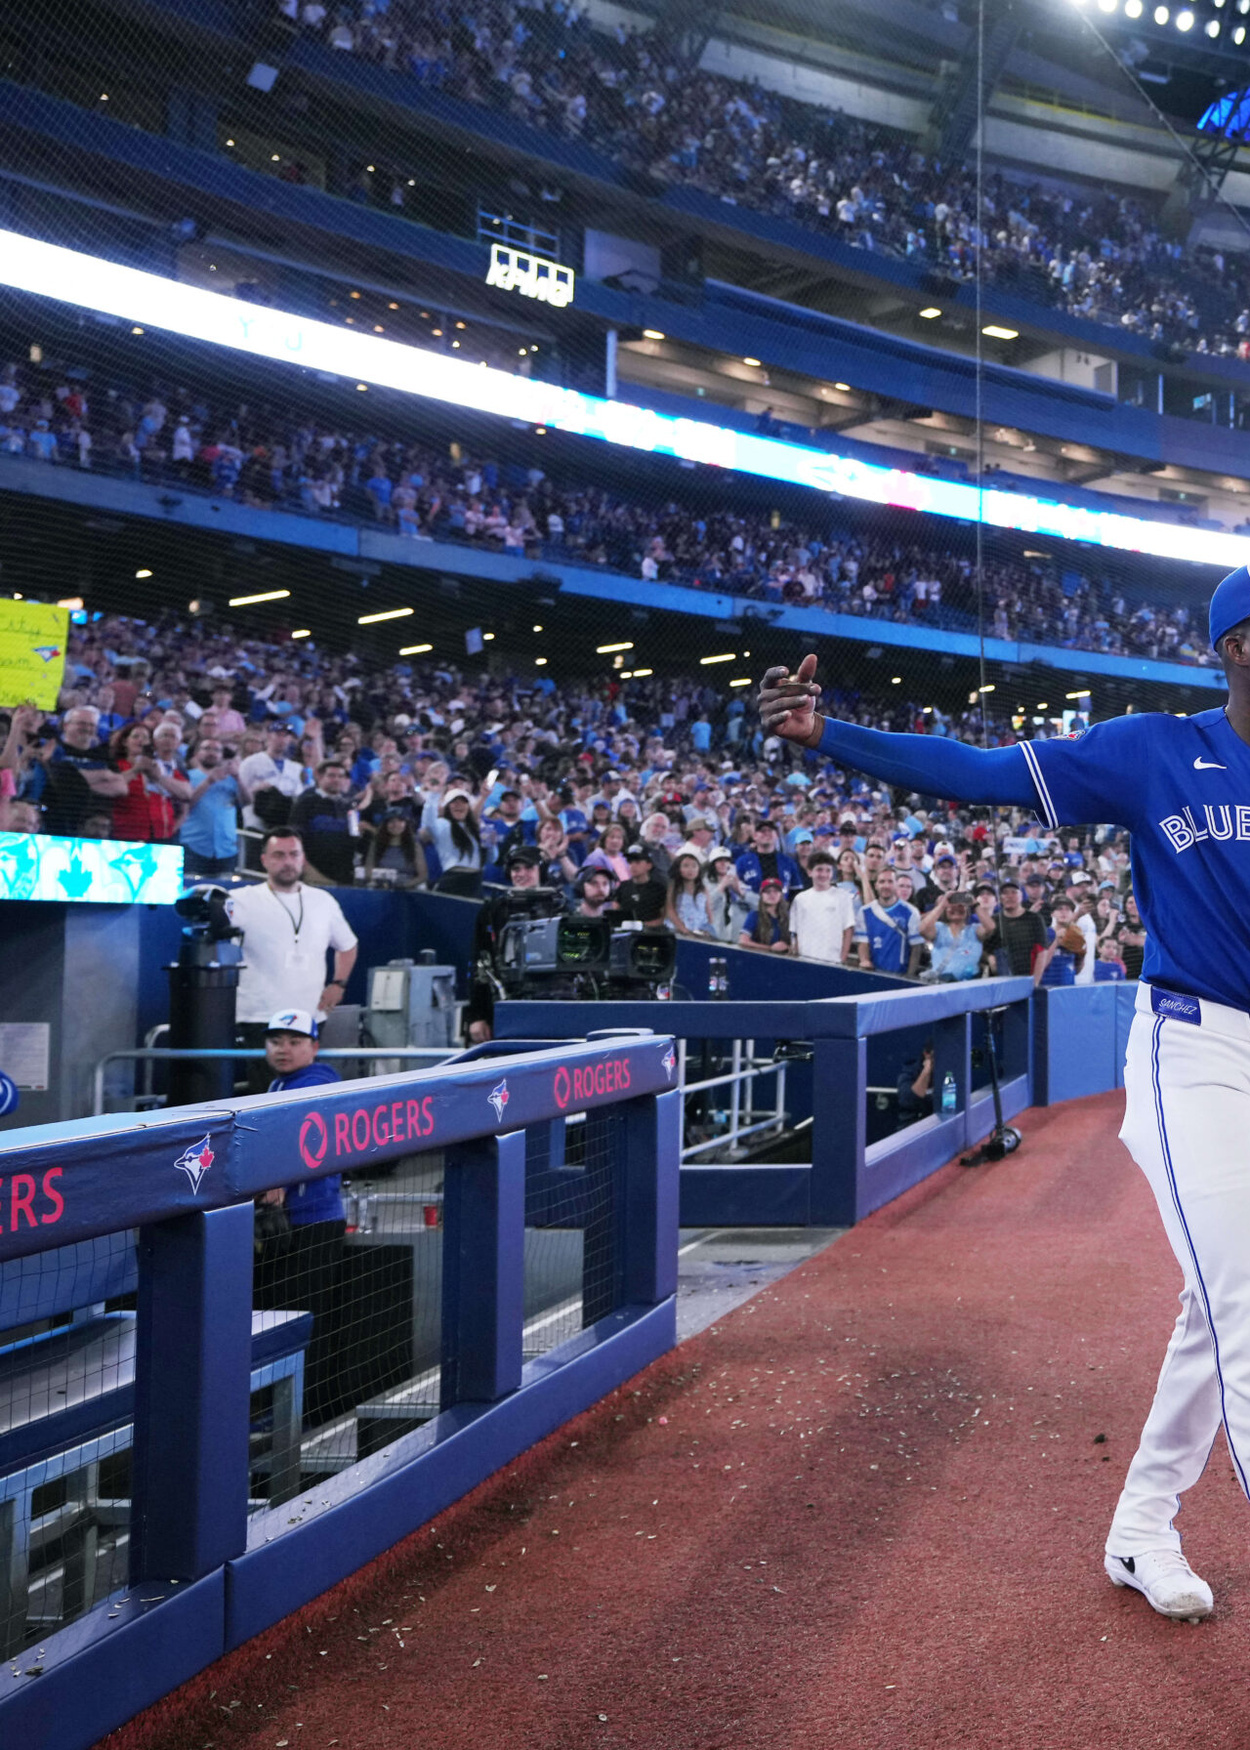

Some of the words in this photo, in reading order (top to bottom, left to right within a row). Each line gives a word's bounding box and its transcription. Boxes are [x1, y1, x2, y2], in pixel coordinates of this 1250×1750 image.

[485, 244, 574, 307] KPMG
[1159, 998, 1198, 1015] SANCHEZ
[573, 1058, 631, 1100] ROGERS
[334, 1096, 434, 1156] ROGERS
